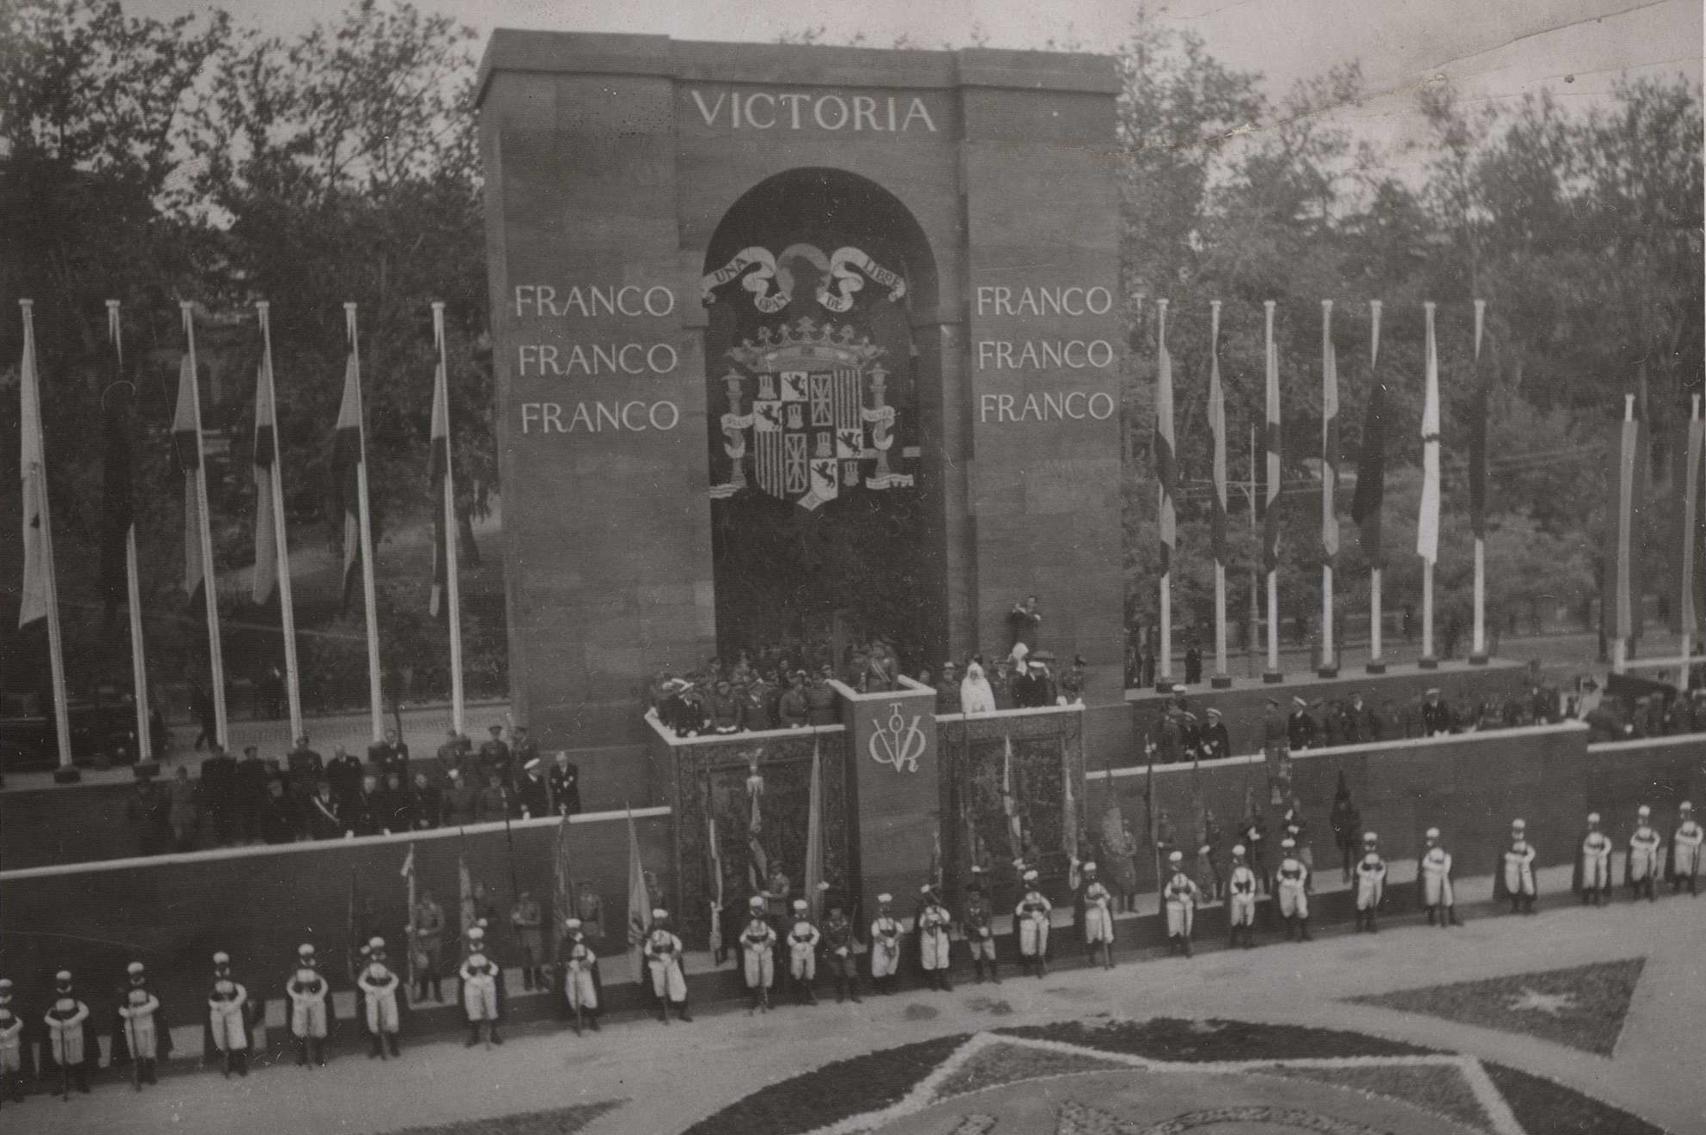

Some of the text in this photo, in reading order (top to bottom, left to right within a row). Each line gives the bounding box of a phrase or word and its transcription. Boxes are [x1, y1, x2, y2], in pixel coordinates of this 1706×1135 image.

[692, 90, 937, 132] VICTORIA
[714, 257, 748, 283] UNA
[515, 285, 675, 317] FRANCO
[977, 286, 1112, 316] FRANCO
[518, 343, 678, 376] FRANCO
[978, 339, 1114, 370] FRANCO
[521, 400, 680, 434] FRANCO
[980, 391, 1115, 422] FRANCO
